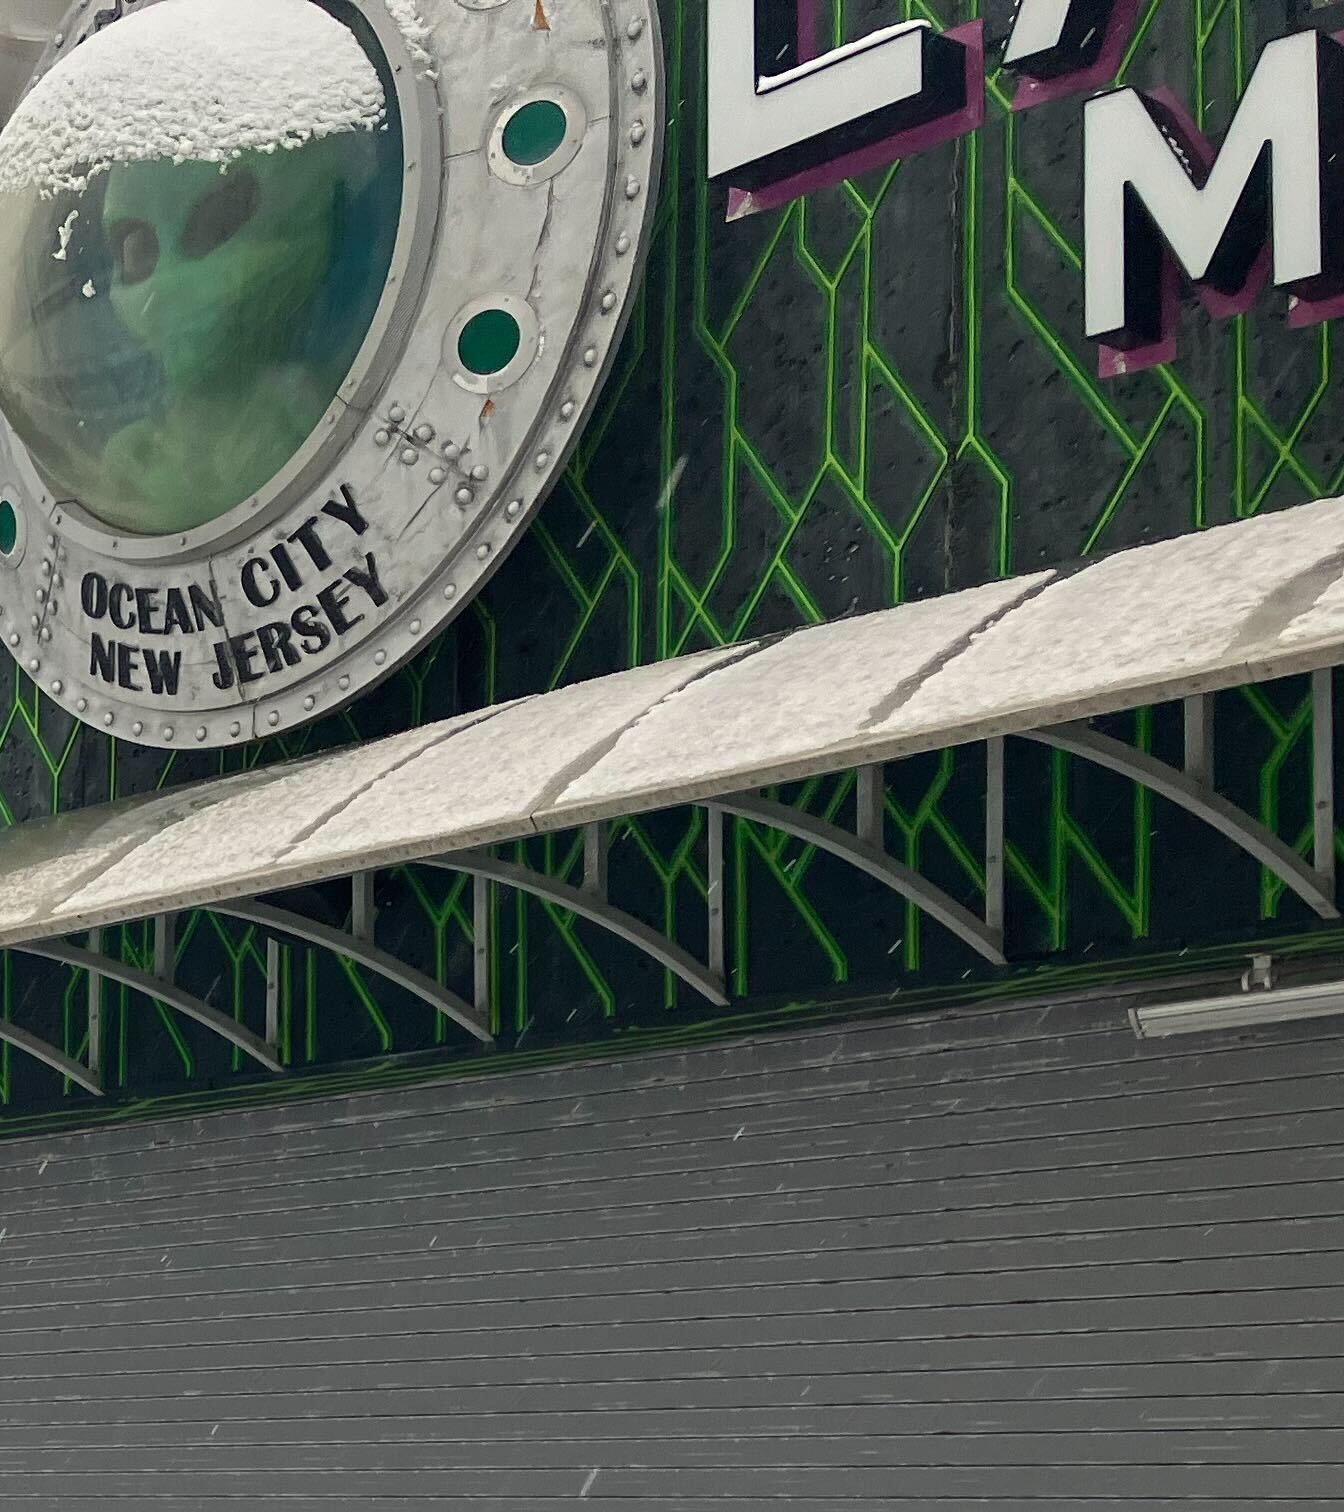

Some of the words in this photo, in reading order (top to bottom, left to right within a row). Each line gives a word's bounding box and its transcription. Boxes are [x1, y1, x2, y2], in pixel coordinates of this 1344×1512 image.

[80, 571, 224, 635] OCEAN
[240, 482, 372, 609] CITY
[89, 632, 182, 696] NEW
[212, 551, 392, 690] JERSEY
